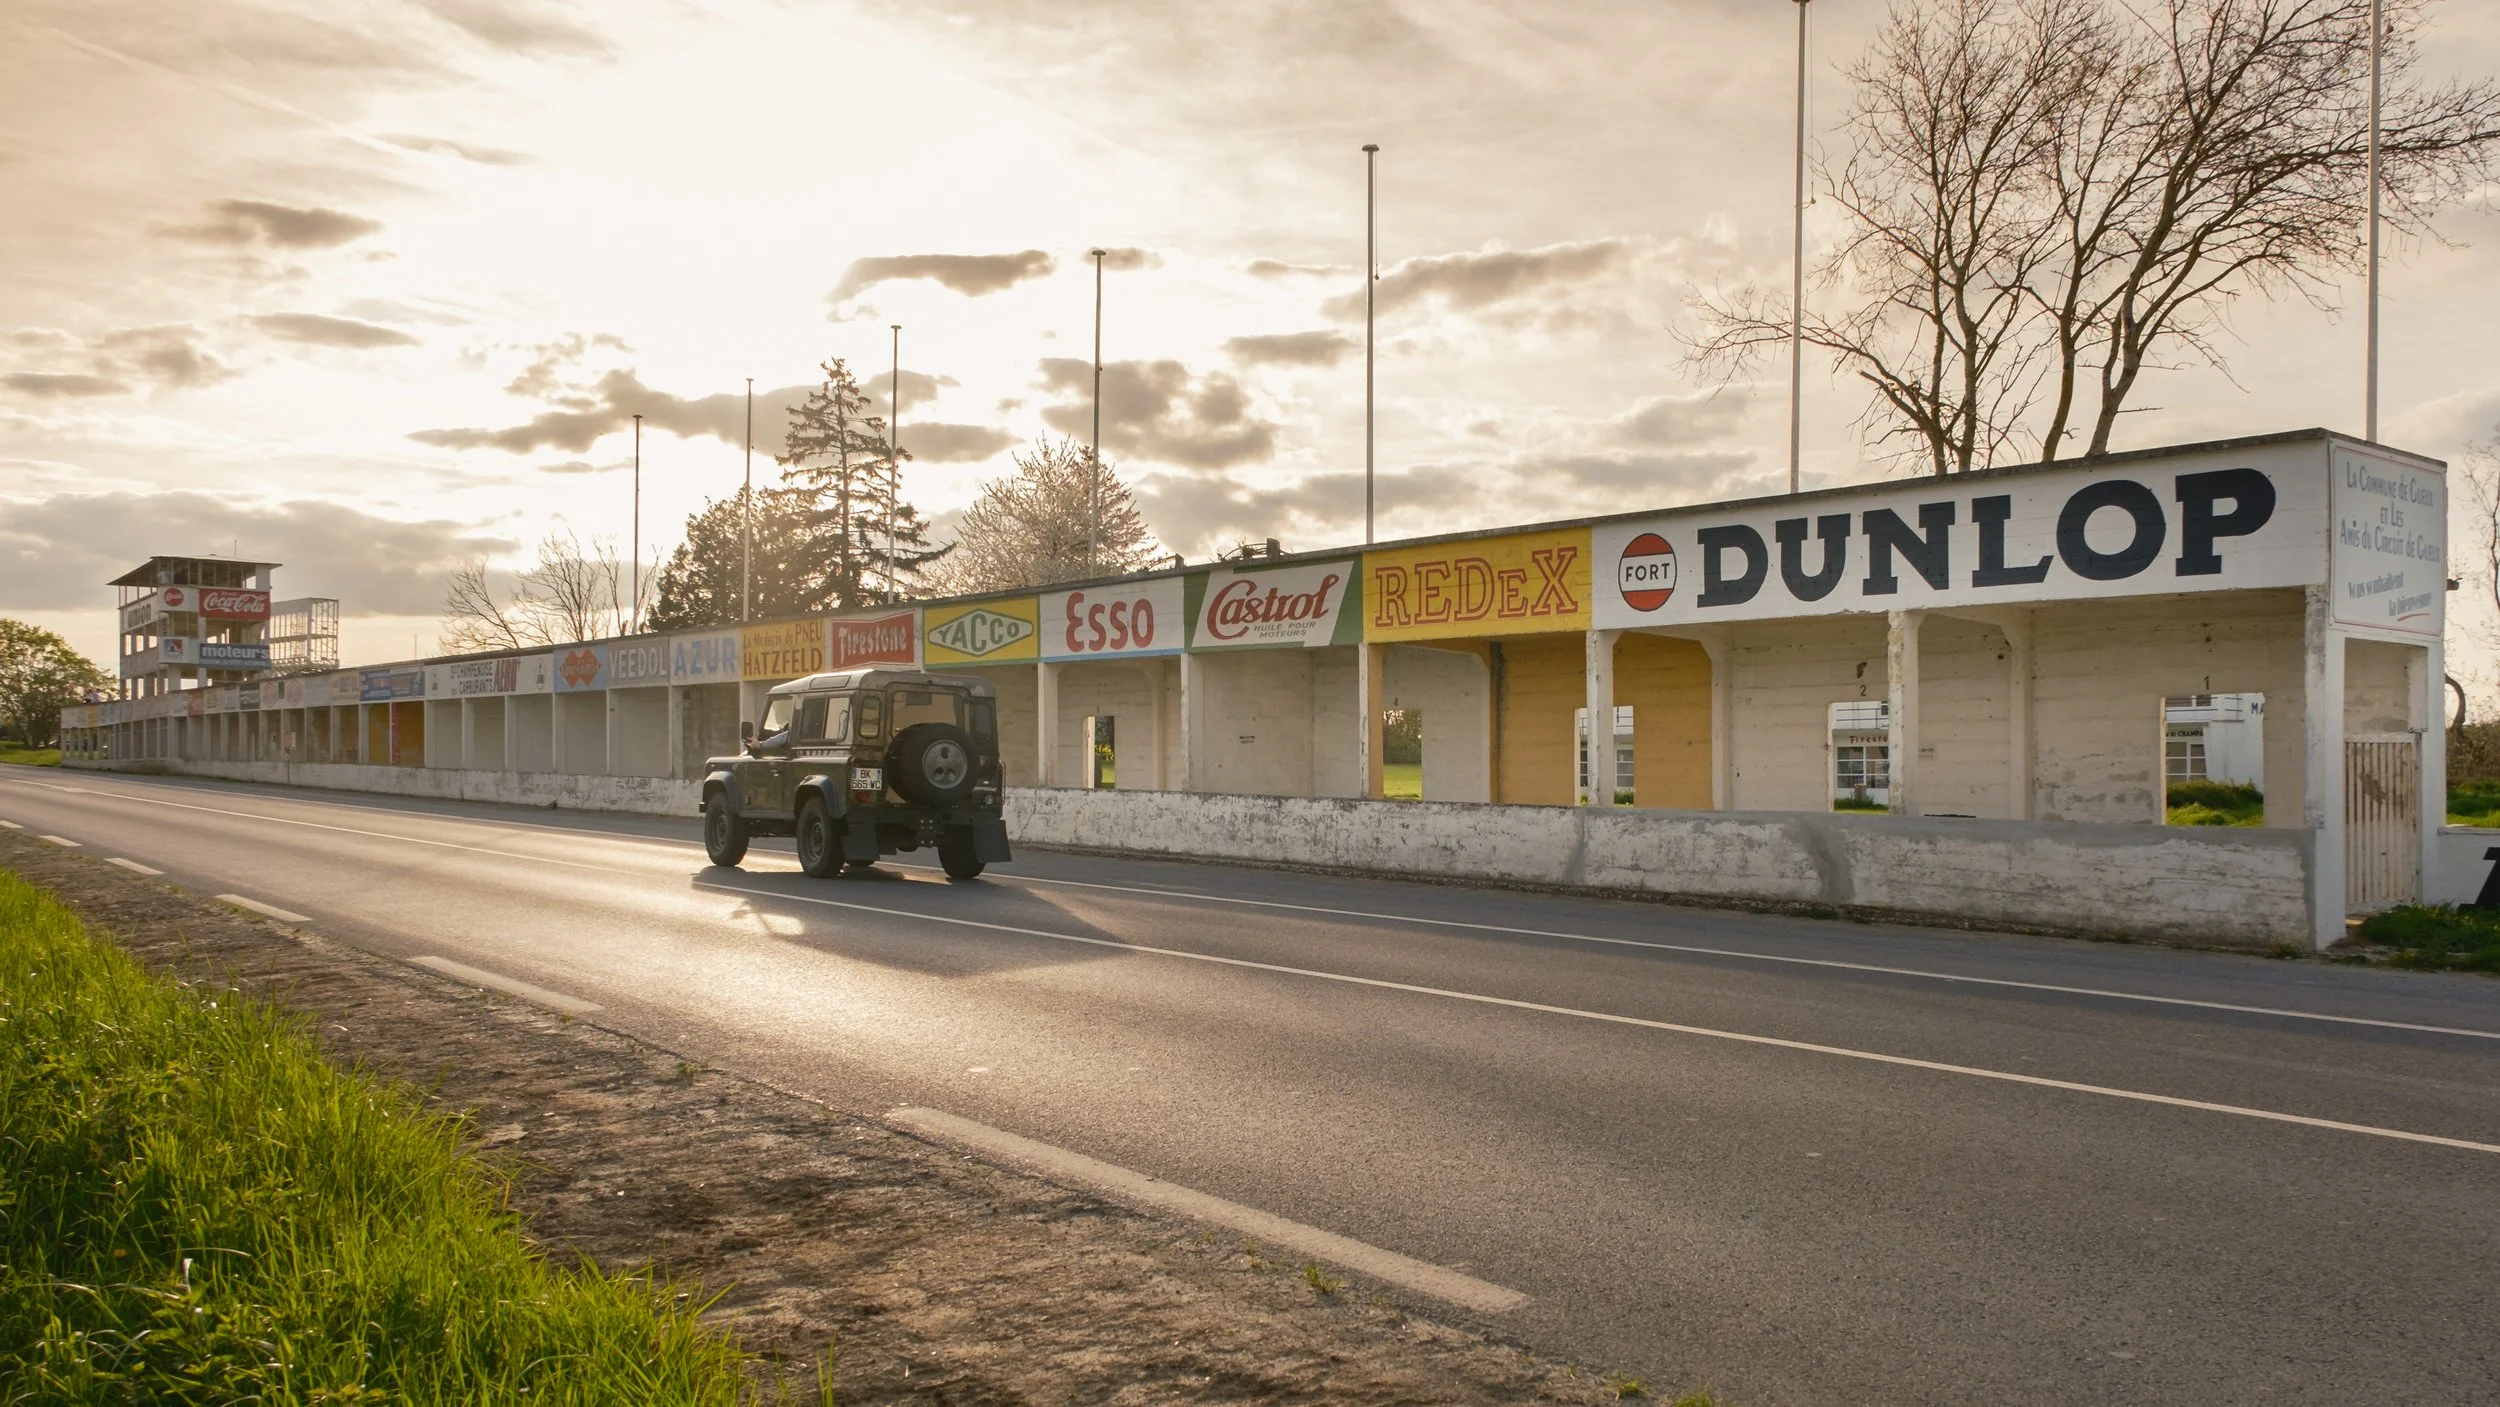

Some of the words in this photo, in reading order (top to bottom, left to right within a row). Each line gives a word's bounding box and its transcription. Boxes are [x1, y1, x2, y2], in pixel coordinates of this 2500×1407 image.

[1697, 467, 2277, 608] DUNLOP
[1624, 561, 1670, 583] FORT
[1206, 573, 1340, 641] Castrol
[795, 620, 823, 644] PNEU
[938, 613, 1020, 652] YACCO
[1253, 623, 1283, 633] HUILE
[1288, 621, 1316, 631] POUR
[1258, 629, 1307, 639] MOTEURS
[202, 645, 269, 660] moteurs
[674, 636, 737, 677] AZUR
[838, 625, 907, 664] Firestone
[608, 647, 667, 679] VEEDOL
[743, 648, 823, 676] HATZFELD
[1860, 684, 1867, 697] 2
[2203, 675, 2210, 690] 1
